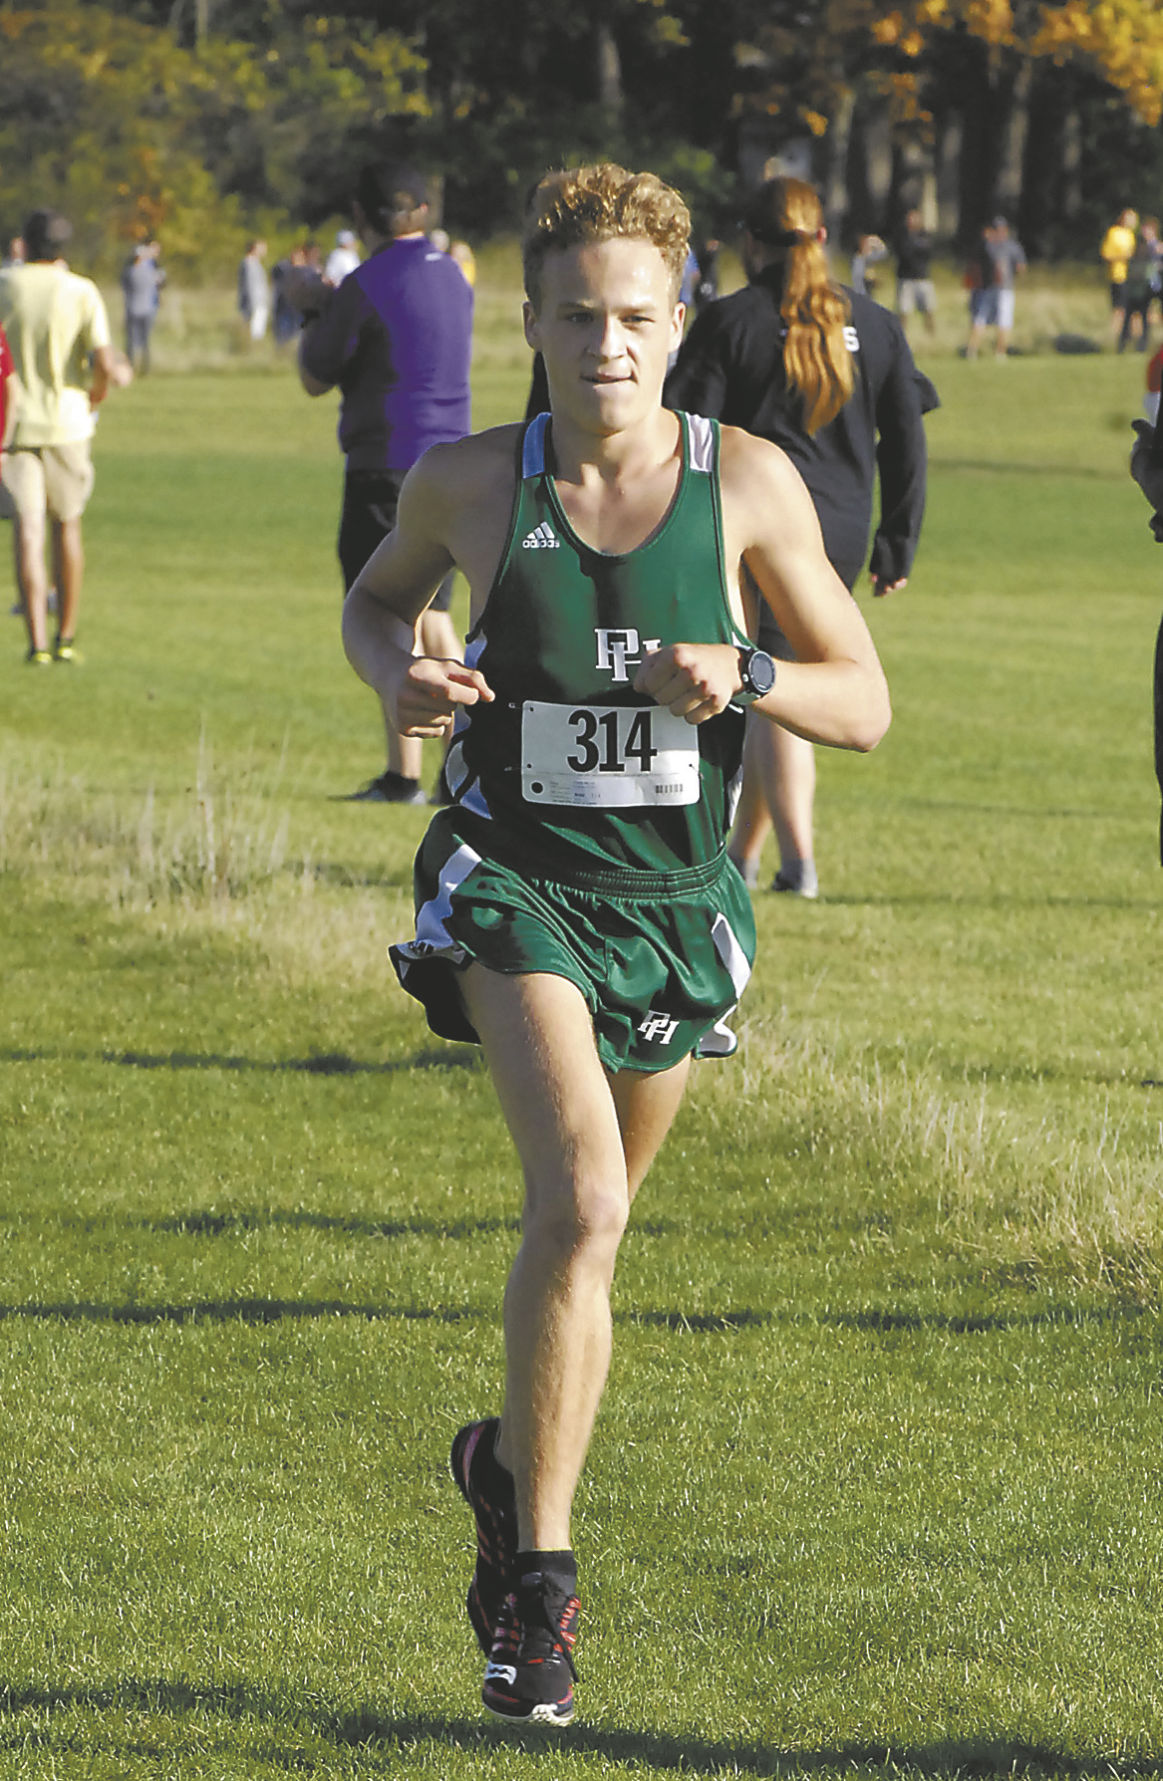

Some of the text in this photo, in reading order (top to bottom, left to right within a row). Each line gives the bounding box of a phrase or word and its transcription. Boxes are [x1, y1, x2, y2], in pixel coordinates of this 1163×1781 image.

[522, 539, 560, 548] adidas
[567, 709, 657, 773] 314
[637, 1010, 679, 1044] PH
